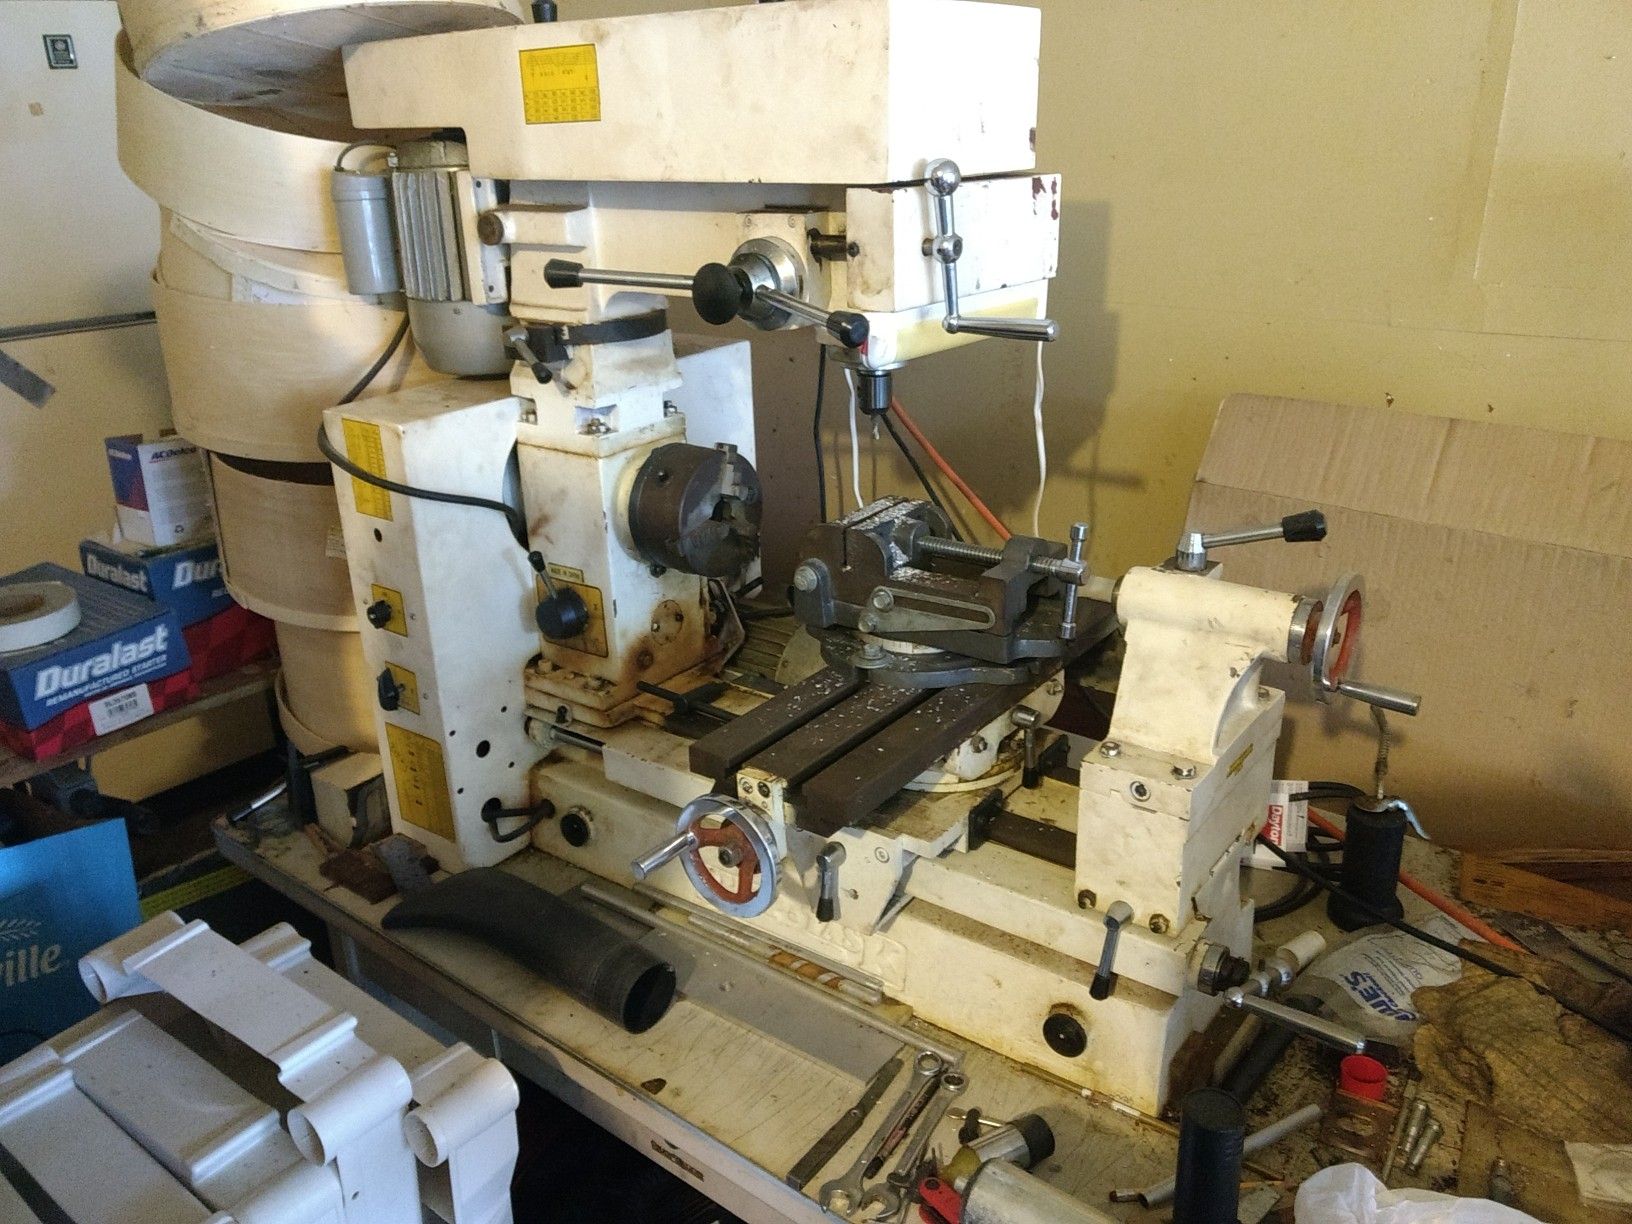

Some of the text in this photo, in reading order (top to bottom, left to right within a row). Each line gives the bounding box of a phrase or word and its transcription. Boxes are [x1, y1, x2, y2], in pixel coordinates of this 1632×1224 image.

[86, 554, 148, 592] Duralast
[171, 559, 221, 590] Dur
[34, 623, 169, 701] Duralast
